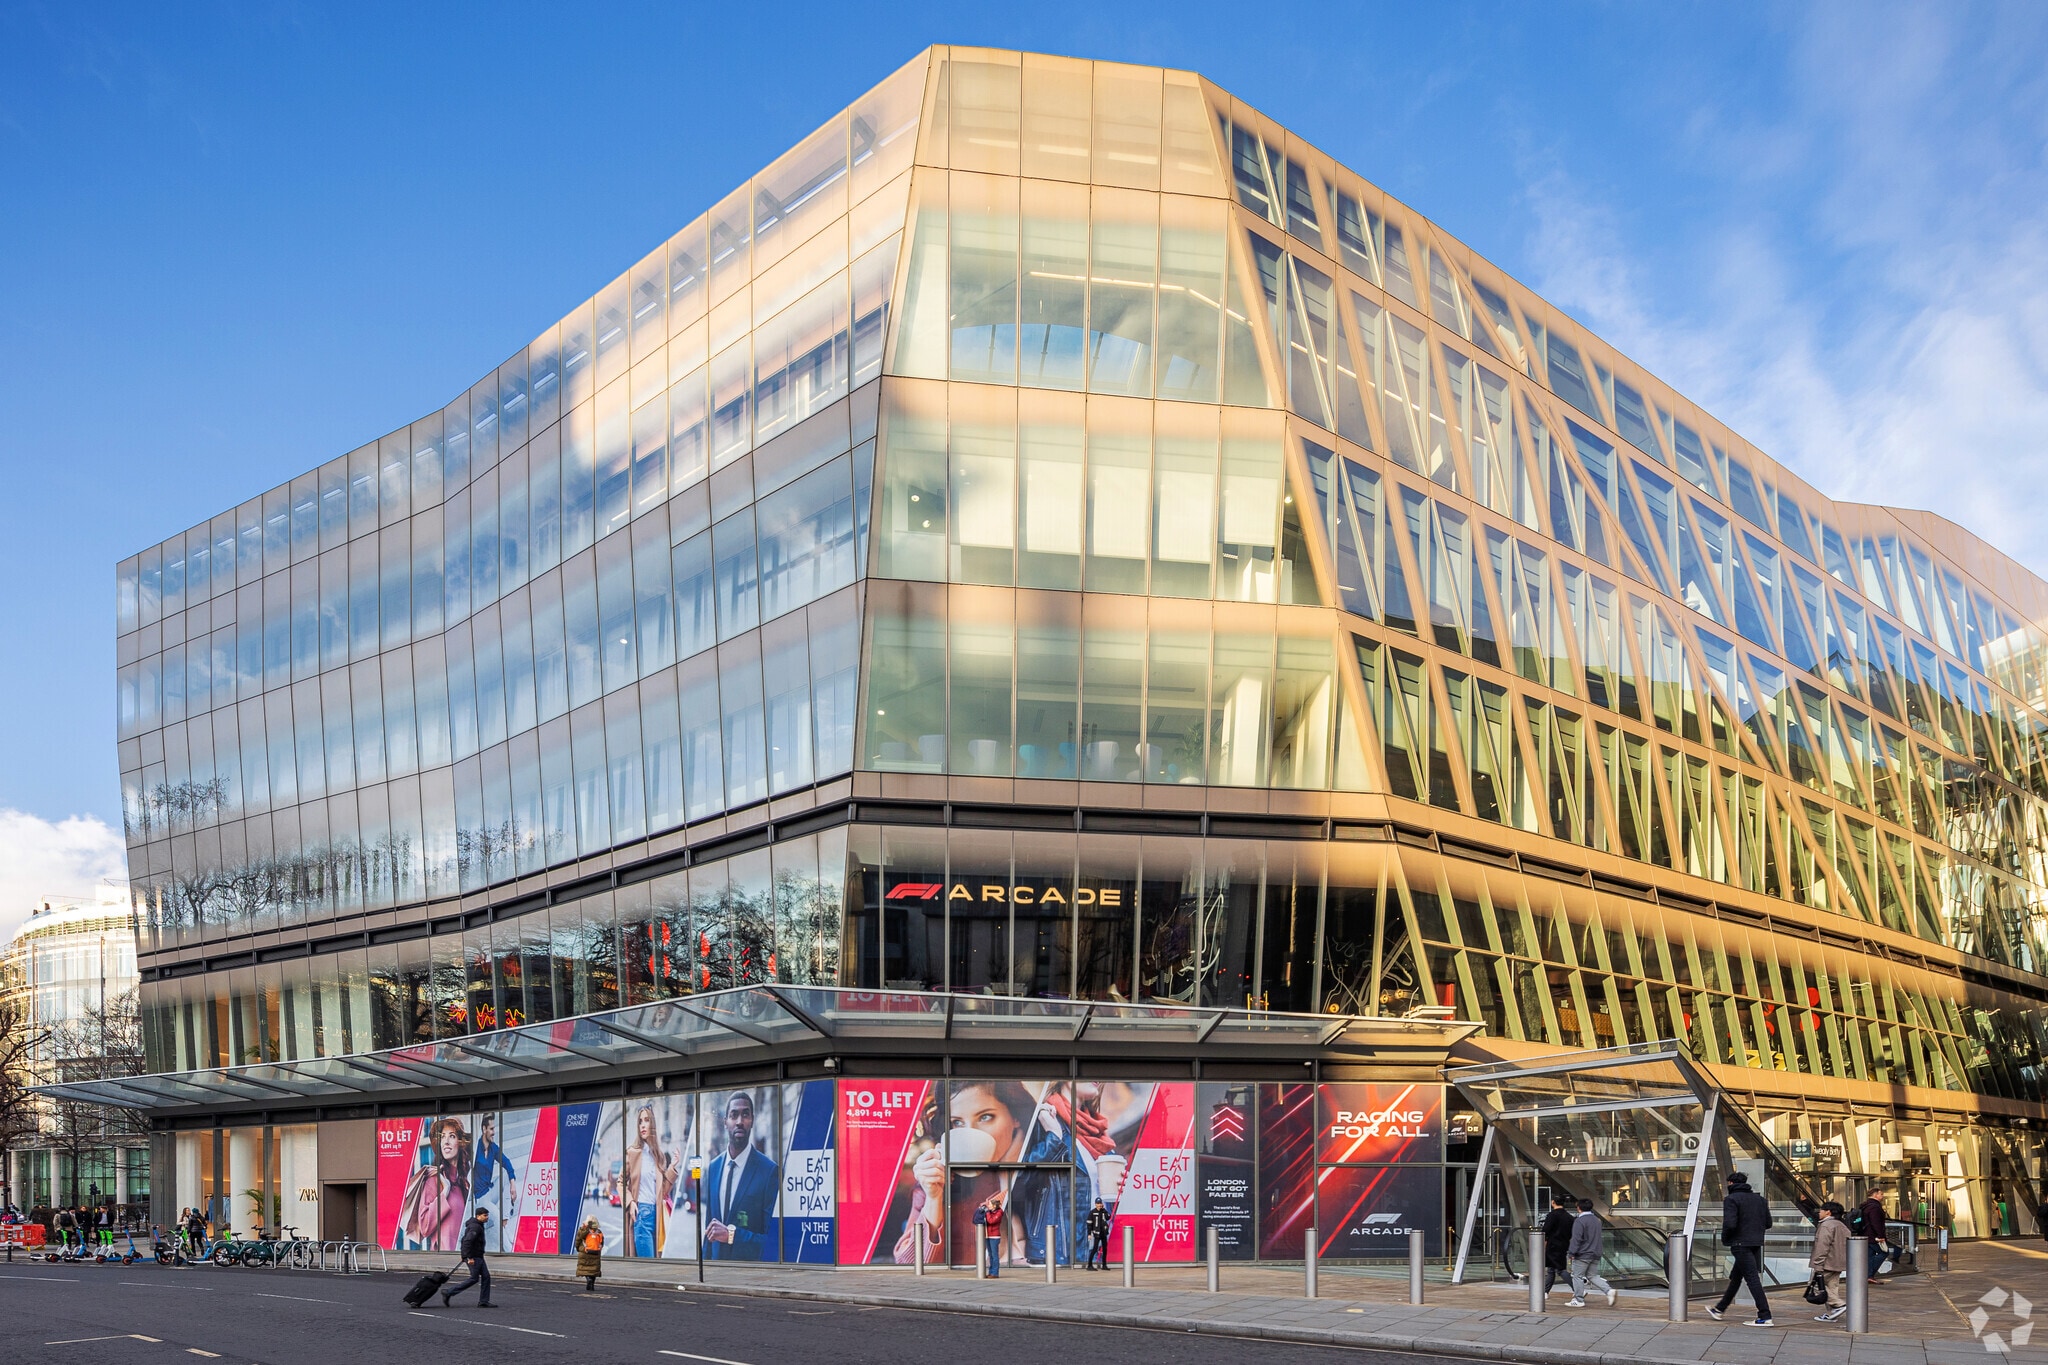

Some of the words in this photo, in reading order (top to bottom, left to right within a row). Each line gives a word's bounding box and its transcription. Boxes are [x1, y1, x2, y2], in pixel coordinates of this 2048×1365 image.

[949, 883, 1121, 905] ARCADE
[845, 1090, 875, 1108] TO
[881, 1091, 914, 1108] LET
[846, 1109, 870, 1117] 4,891
[873, 1111, 883, 1119] sq
[884, 1109, 892, 1117] ft
[1336, 1110, 1424, 1123] RACING
[380, 1130, 394, 1142] TO
[396, 1130, 412, 1142] LET
[1331, 1125, 1380, 1138] FOR
[1385, 1125, 1430, 1137] ALL
[806, 1157, 830, 1173] EAT
[1160, 1156, 1190, 1171] EAT
[541, 1168, 557, 1181] EAT
[787, 1176, 824, 1192] SHOP
[1133, 1174, 1182, 1190] SHOP
[527, 1183, 553, 1196] SHOP
[536, 1199, 558, 1212] PLAY
[800, 1195, 831, 1211] PLAY
[1150, 1193, 1190, 1209] PLAY
[537, 1220, 545, 1229] IN
[545, 1220, 557, 1229] THE
[801, 1221, 811, 1232] IN
[813, 1221, 829, 1232] THE
[1152, 1219, 1166, 1230] IN
[1168, 1219, 1189, 1230] THE
[1350, 1227, 1413, 1235] ARCADE
[543, 1229, 557, 1239] CITY
[810, 1233, 829, 1245] CITY
[1164, 1231, 1189, 1242] CITY
